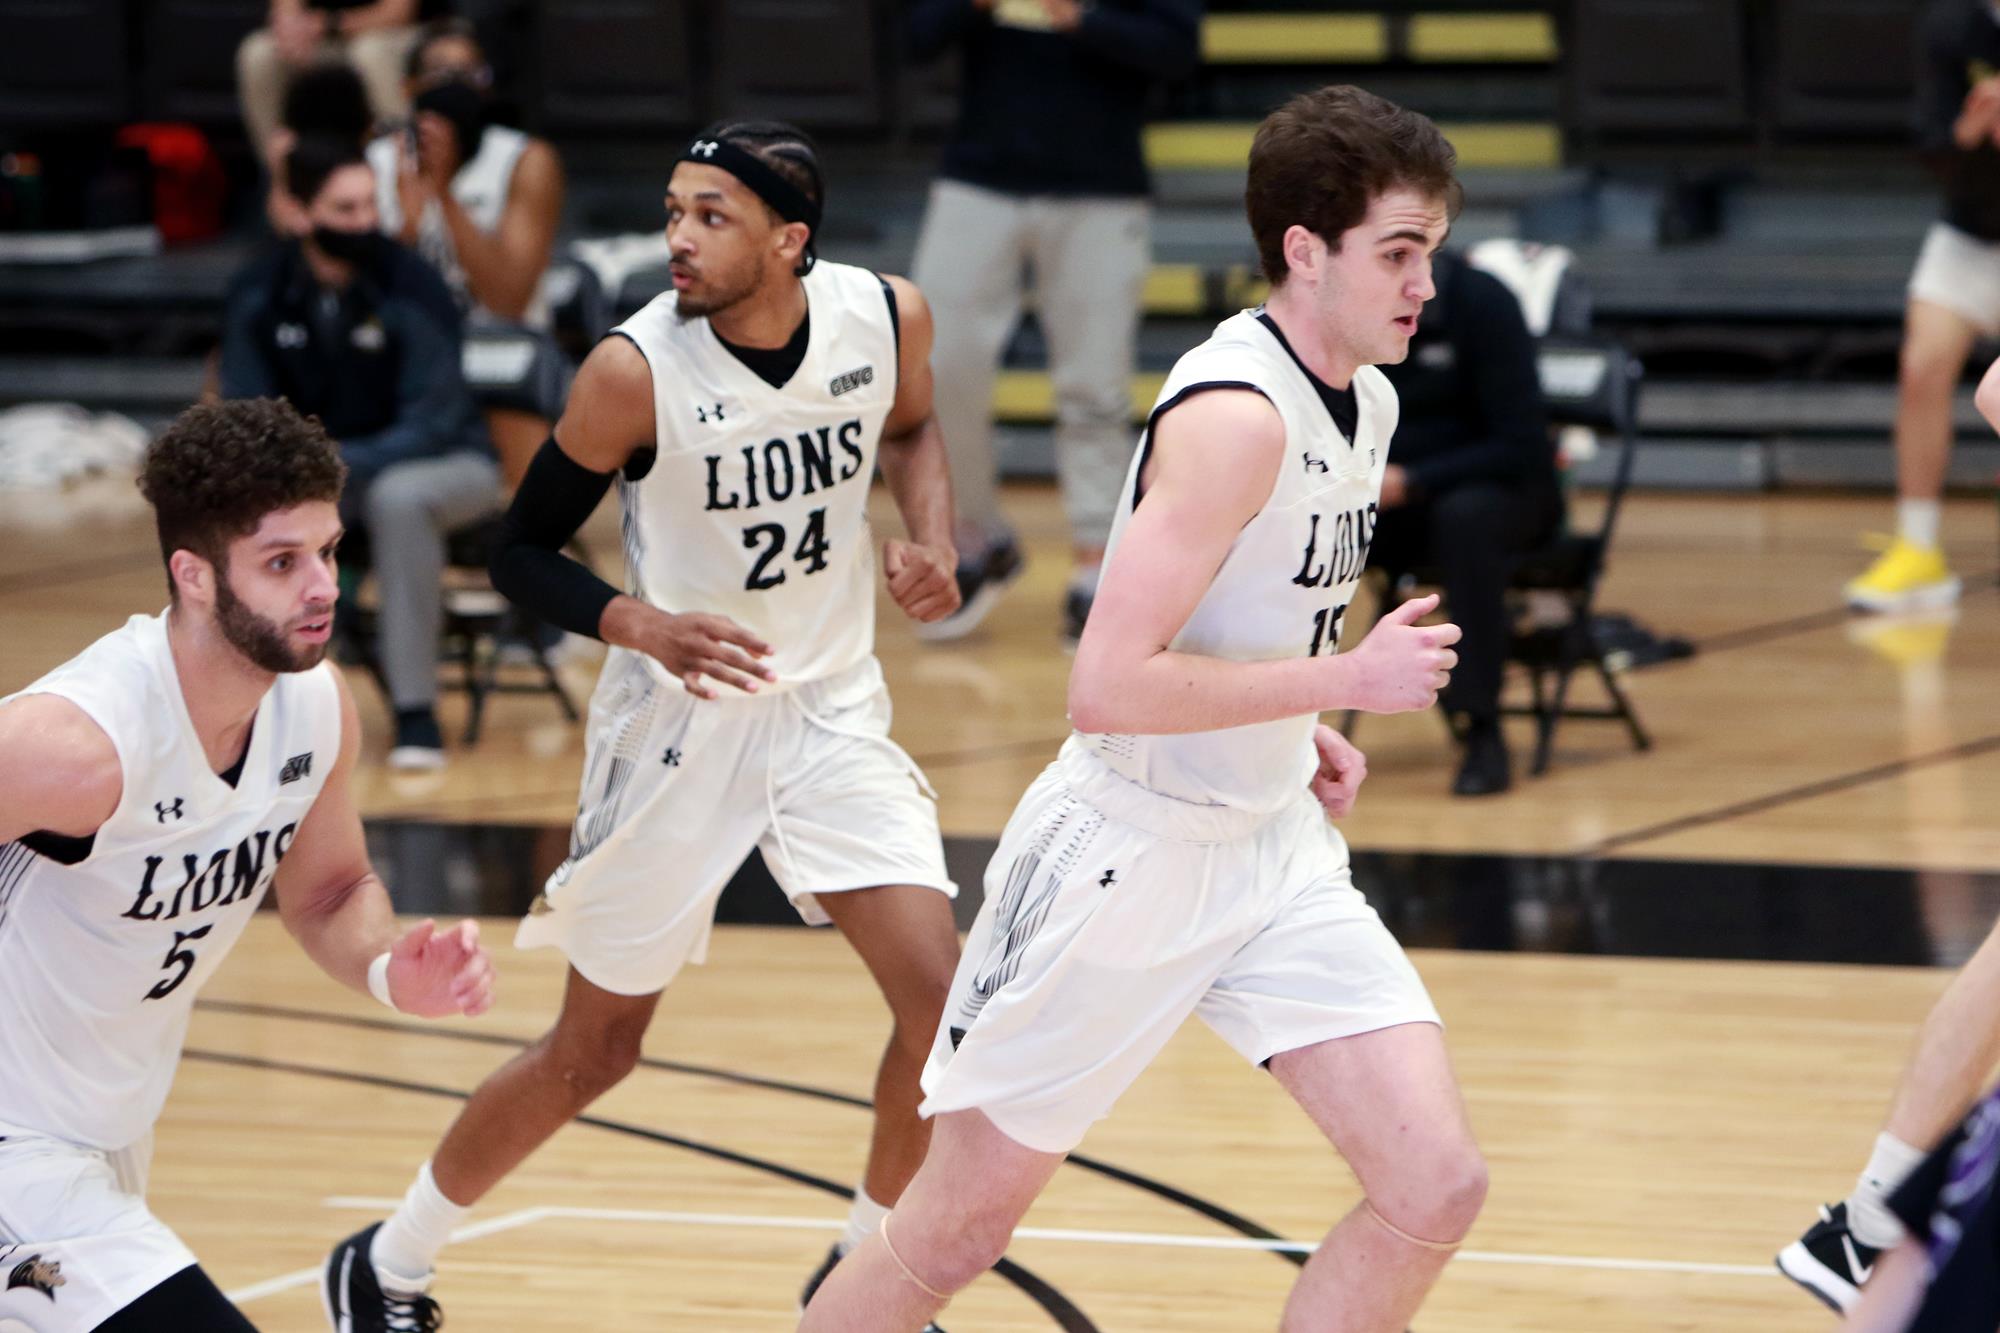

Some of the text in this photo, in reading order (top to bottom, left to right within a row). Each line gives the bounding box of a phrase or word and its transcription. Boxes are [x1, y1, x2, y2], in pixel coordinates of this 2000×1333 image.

[704, 417, 863, 511] LIONS
[742, 506, 829, 590] 24
[120, 820, 298, 920] LIONS
[141, 923, 214, 1002] 5
